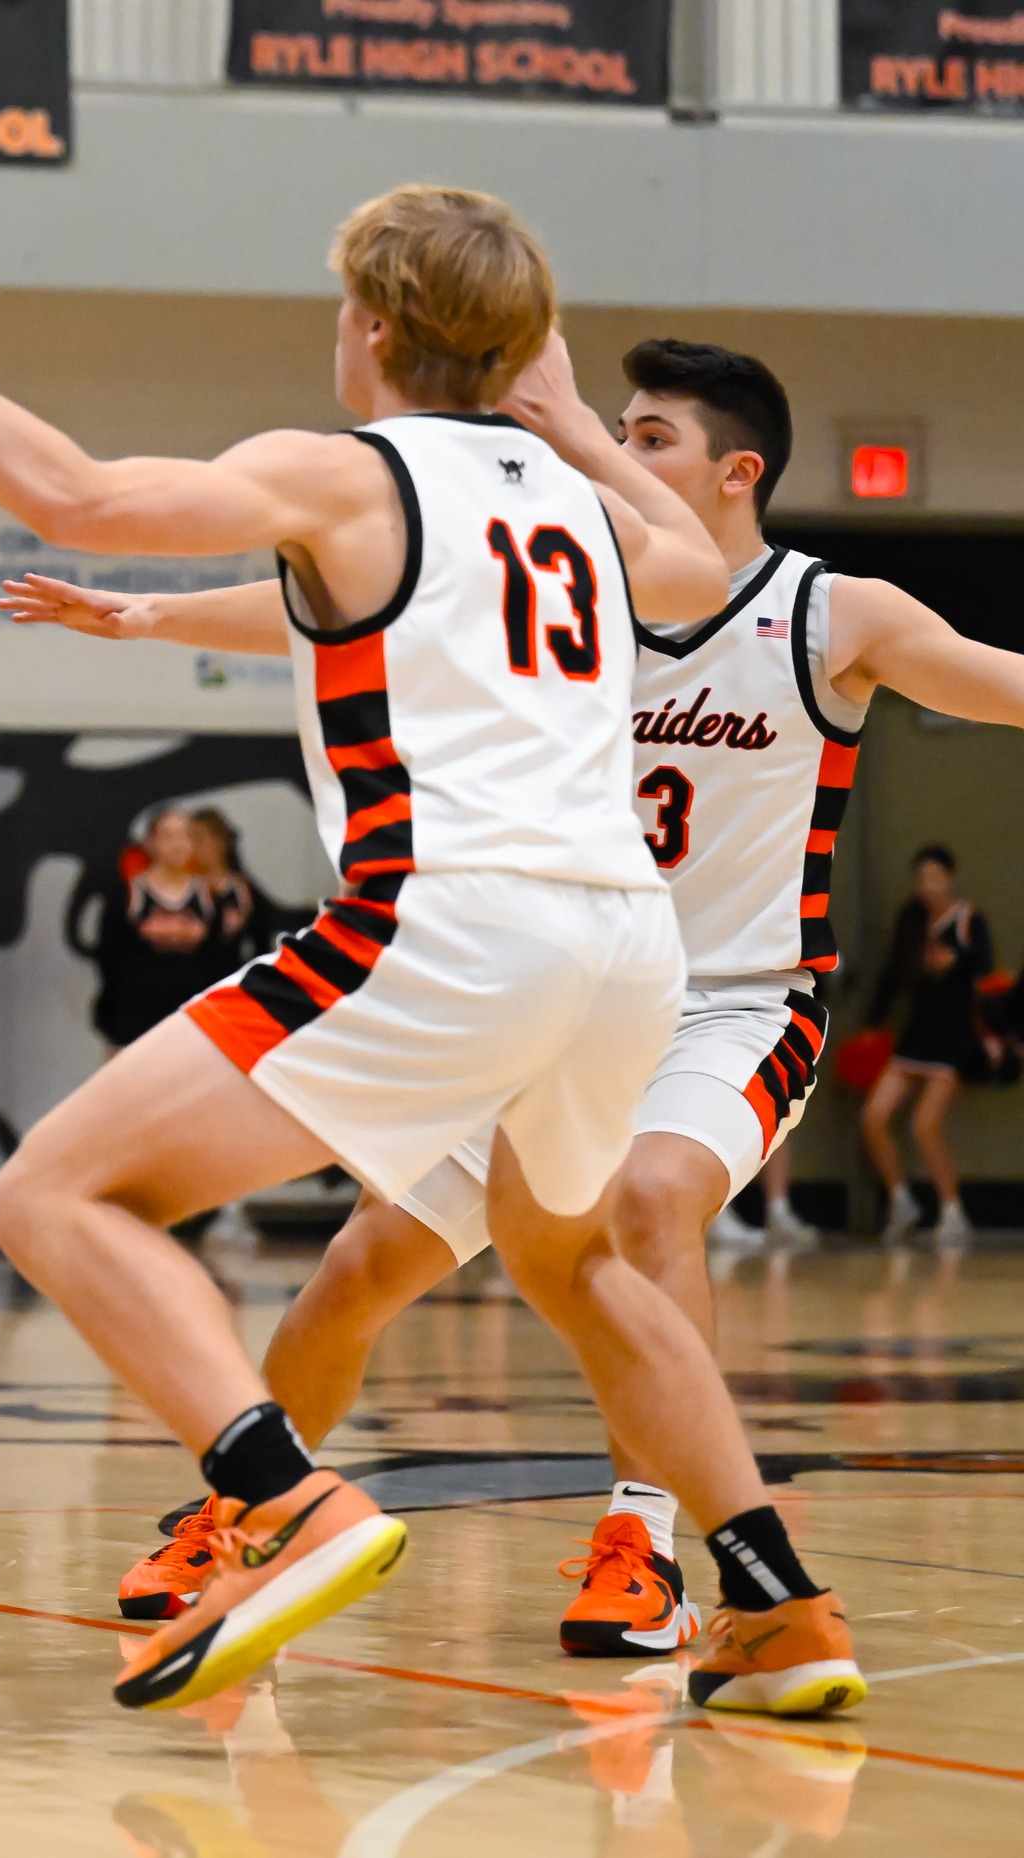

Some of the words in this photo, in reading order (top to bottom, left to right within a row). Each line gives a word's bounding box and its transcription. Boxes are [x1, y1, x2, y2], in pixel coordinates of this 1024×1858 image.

[250, 31, 355, 77] RYLE
[361, 37, 469, 82] HIGH
[477, 40, 637, 94] SCHOOL
[871, 55, 967, 98] RYLE
[486, 517, 602, 682] 13
[637, 765, 695, 869] 3
